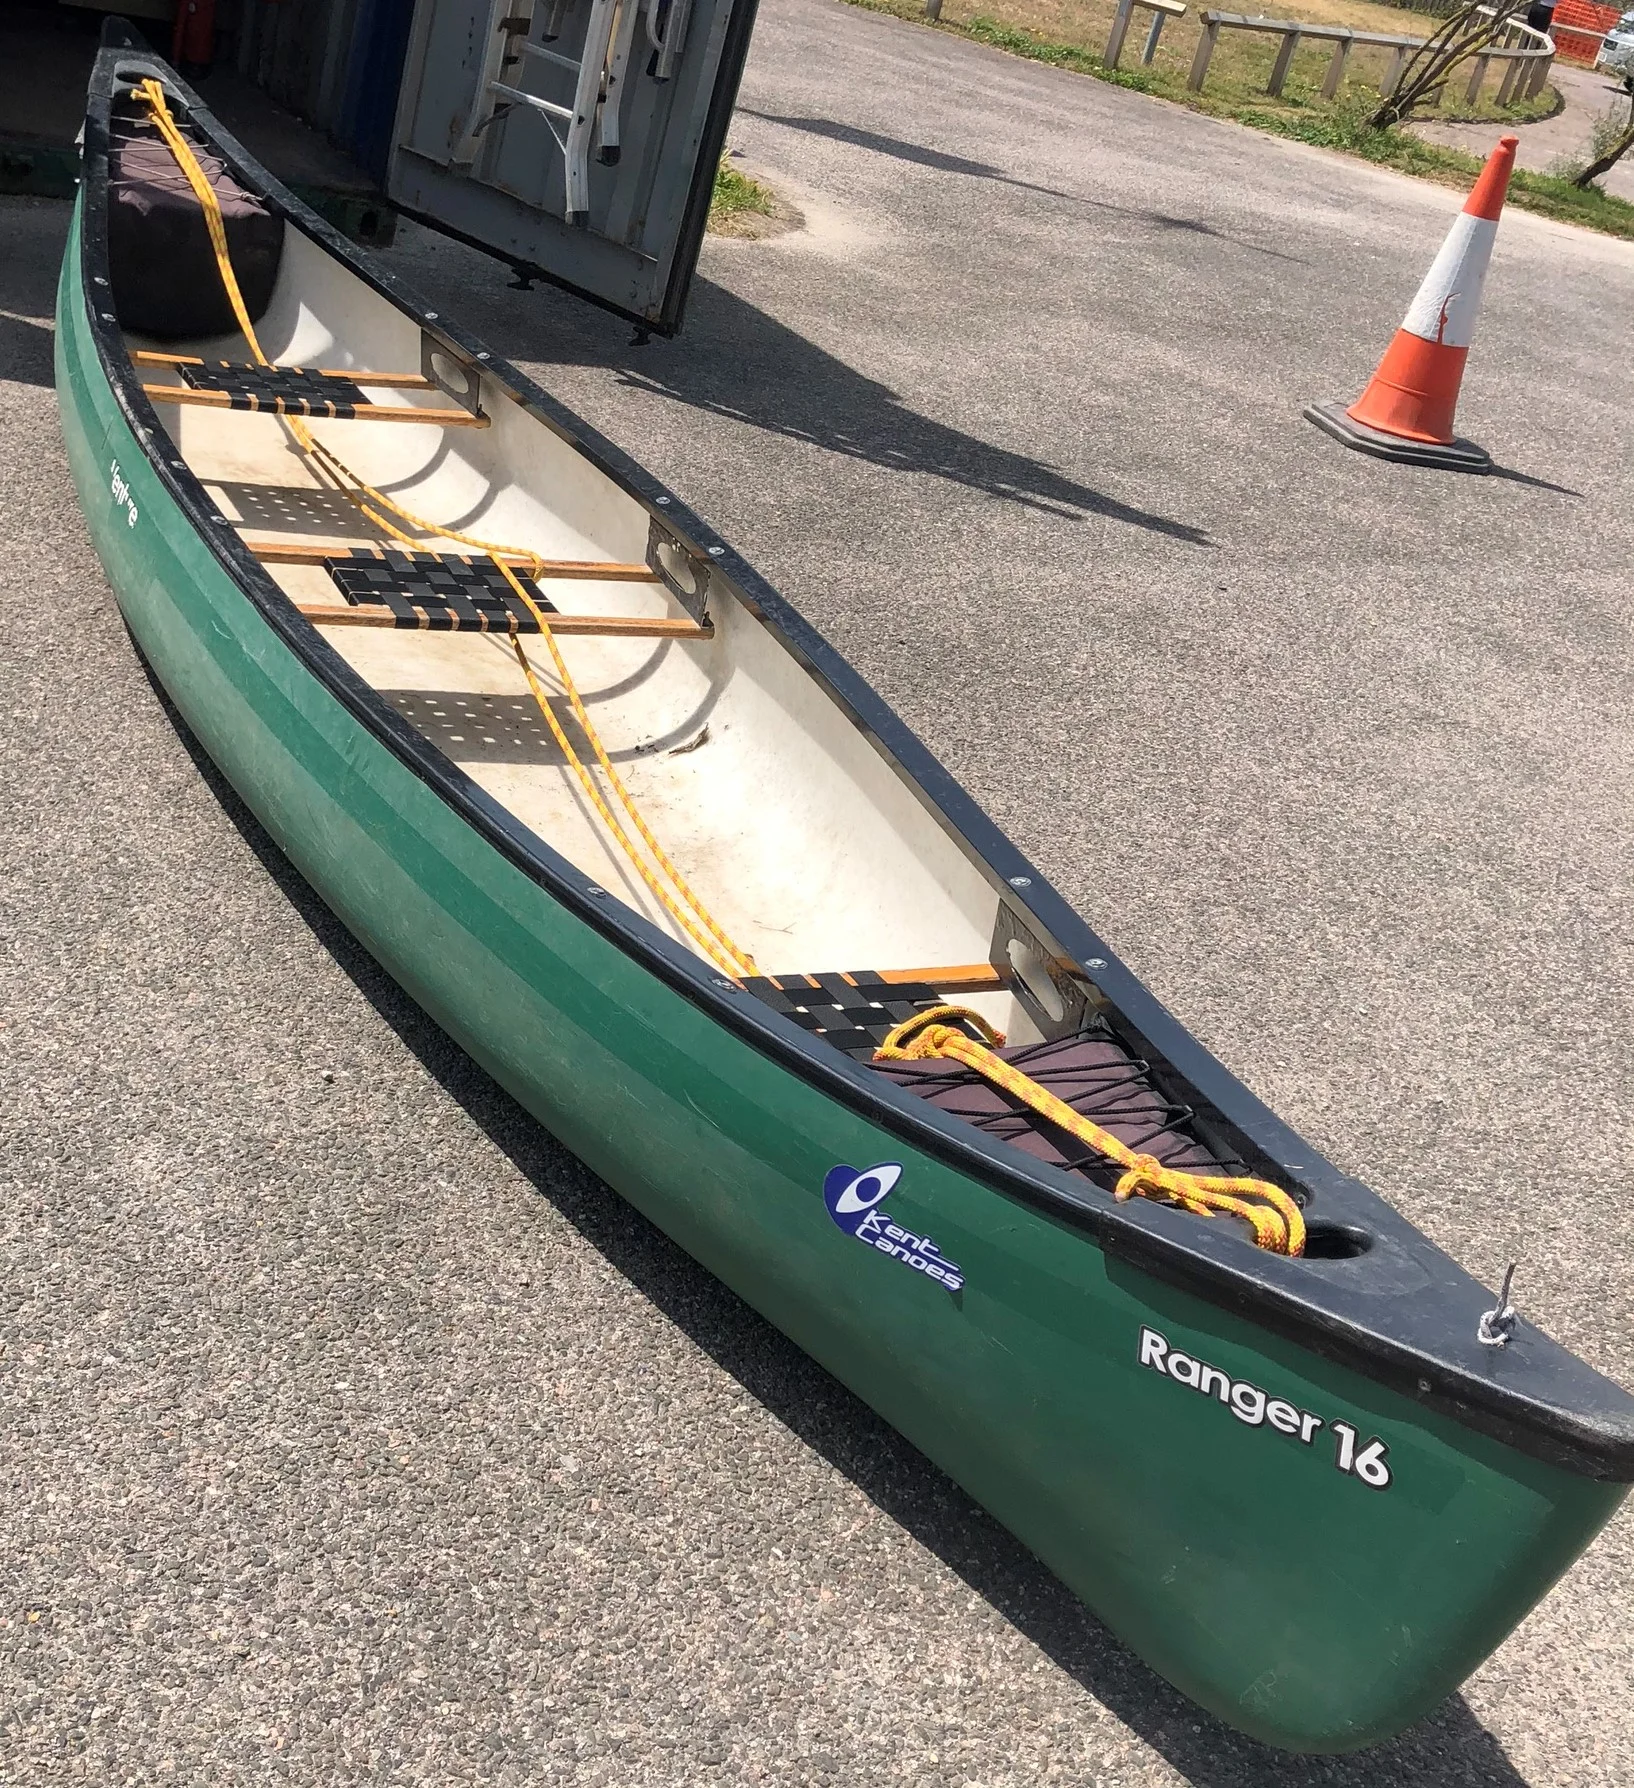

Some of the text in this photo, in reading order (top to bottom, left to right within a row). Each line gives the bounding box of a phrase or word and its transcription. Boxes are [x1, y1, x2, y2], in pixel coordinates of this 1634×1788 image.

[855, 1223, 964, 1290] Canoes
[862, 1208, 959, 1272] Kent
[1139, 1327, 1390, 1487] Ranger 16
